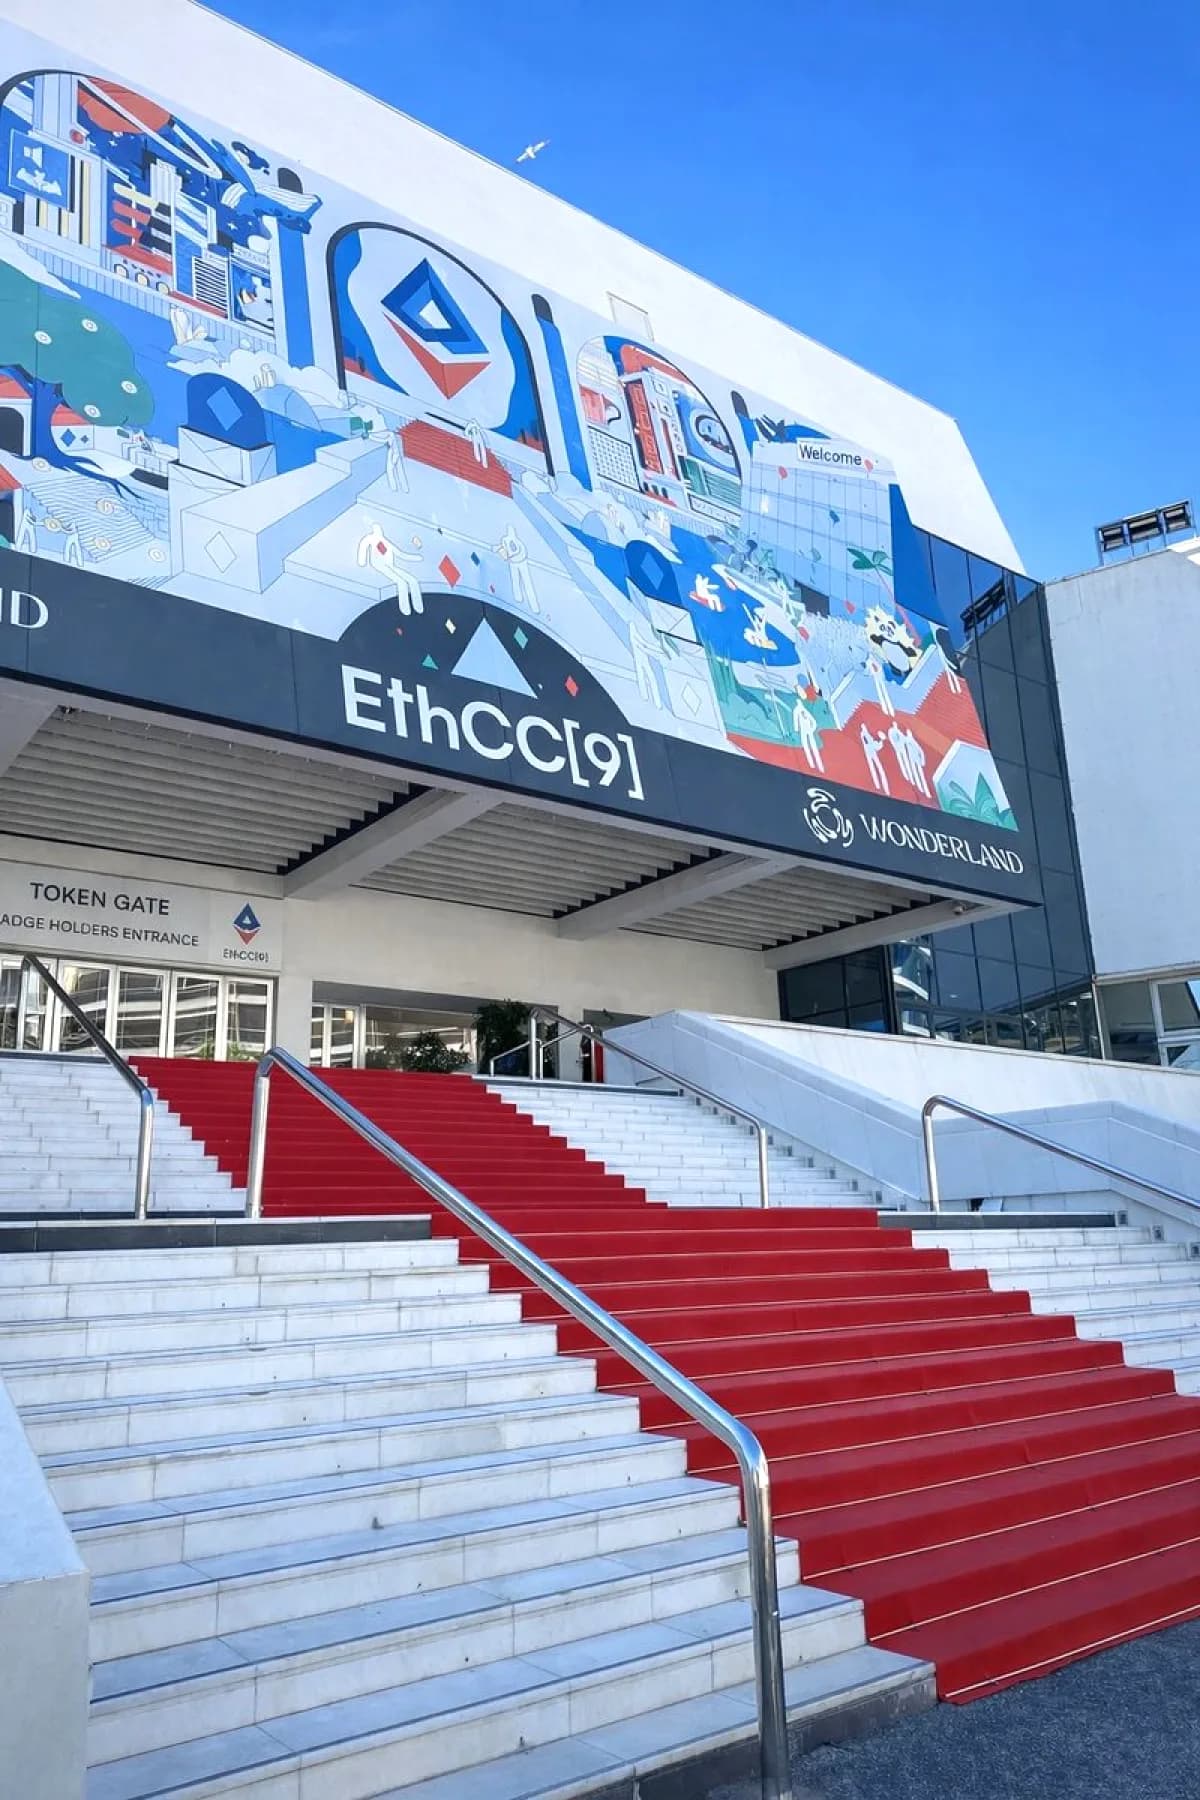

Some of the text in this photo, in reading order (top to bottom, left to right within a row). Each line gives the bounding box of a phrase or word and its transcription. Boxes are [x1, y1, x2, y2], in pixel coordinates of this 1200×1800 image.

[799, 444, 862, 466] Welcome
[0, 587, 49, 630] D
[340, 664, 646, 801] EthCC[9]
[860, 813, 1024, 875] WONDERLAND
[30, 882, 170, 916] TOKEN GATE
[0, 914, 200, 947] ADGE HOLDERS ENTRANCE
